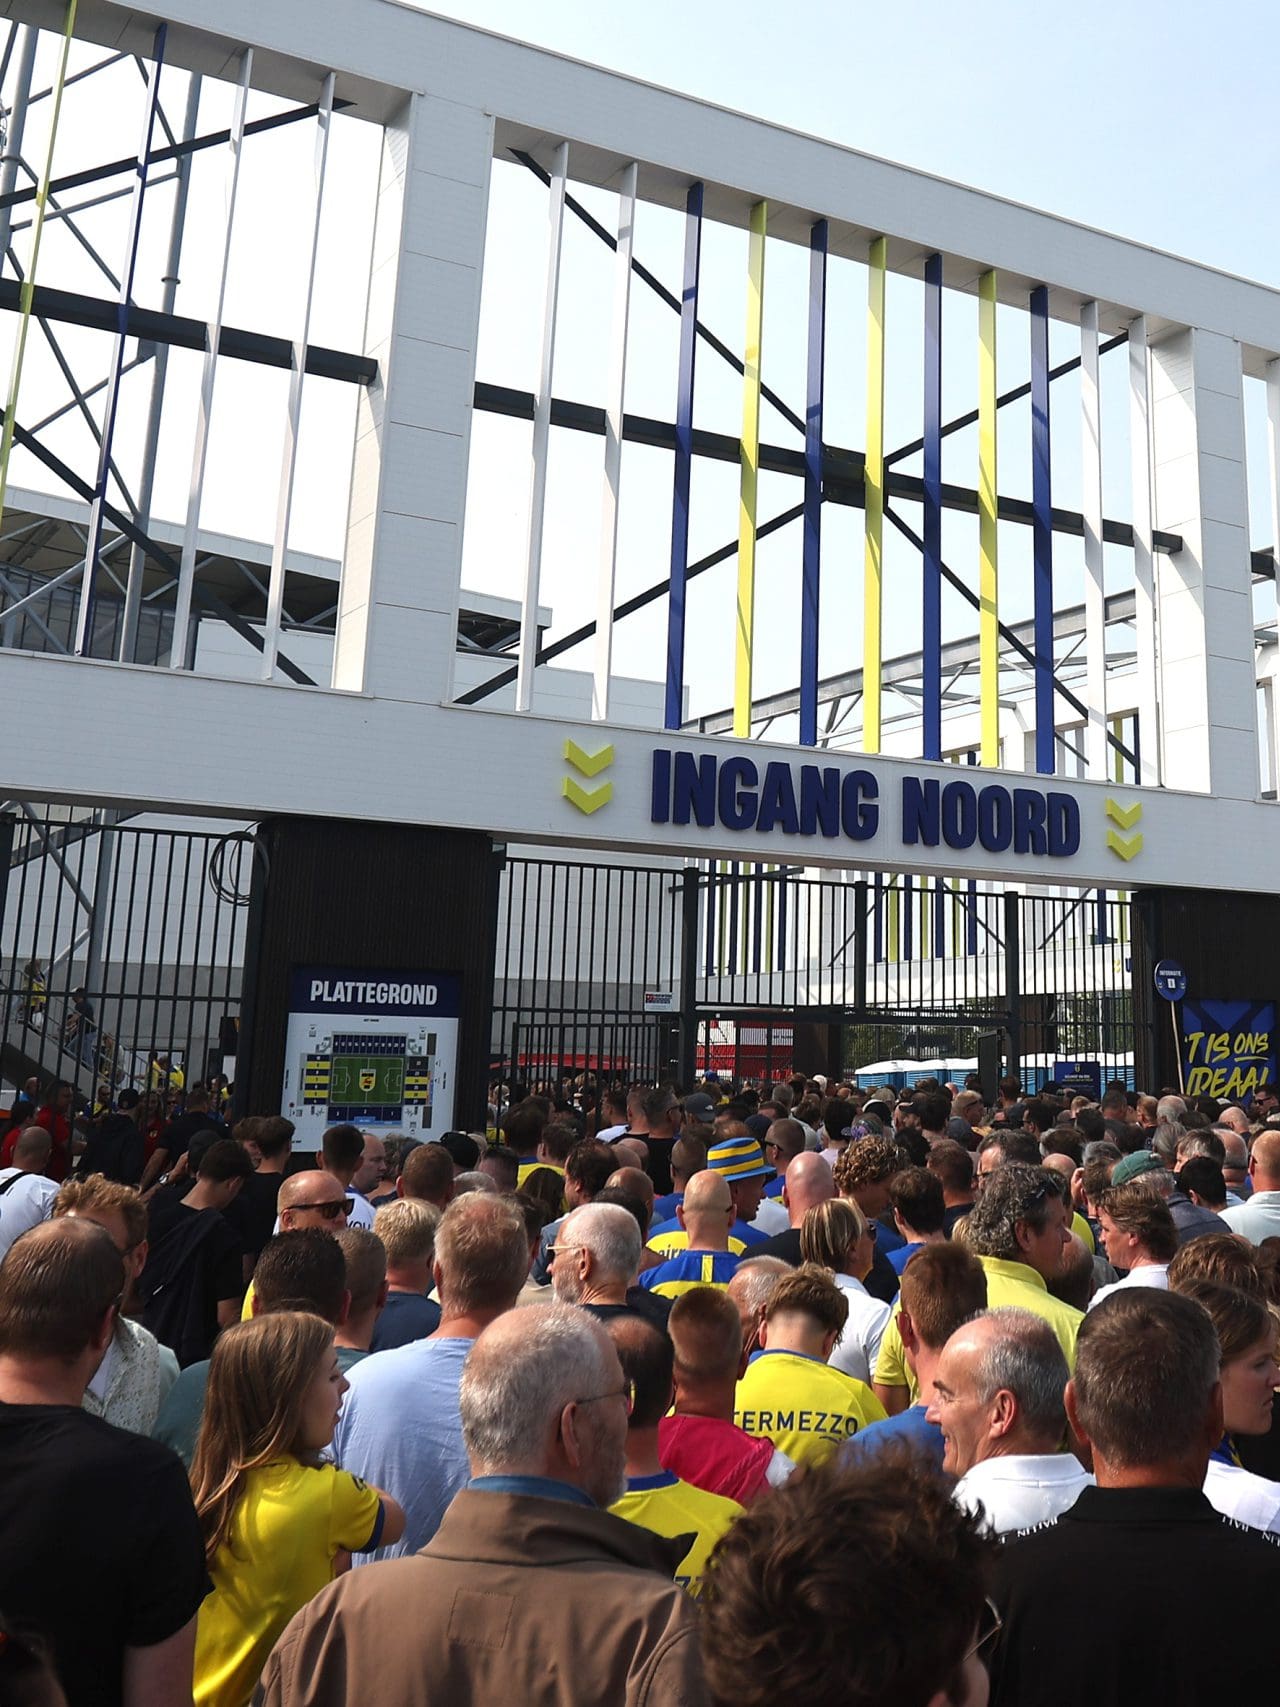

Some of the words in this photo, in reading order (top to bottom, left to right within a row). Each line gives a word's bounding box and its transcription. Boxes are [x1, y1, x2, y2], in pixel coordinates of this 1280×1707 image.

[651, 749, 879, 841] INGANG
[902, 776, 1080, 857] NOORD
[310, 980, 438, 1006] PLATTEGROND
[1233, 1031, 1269, 1055] ONS
[733, 1410, 859, 1437] ERMEZZO
